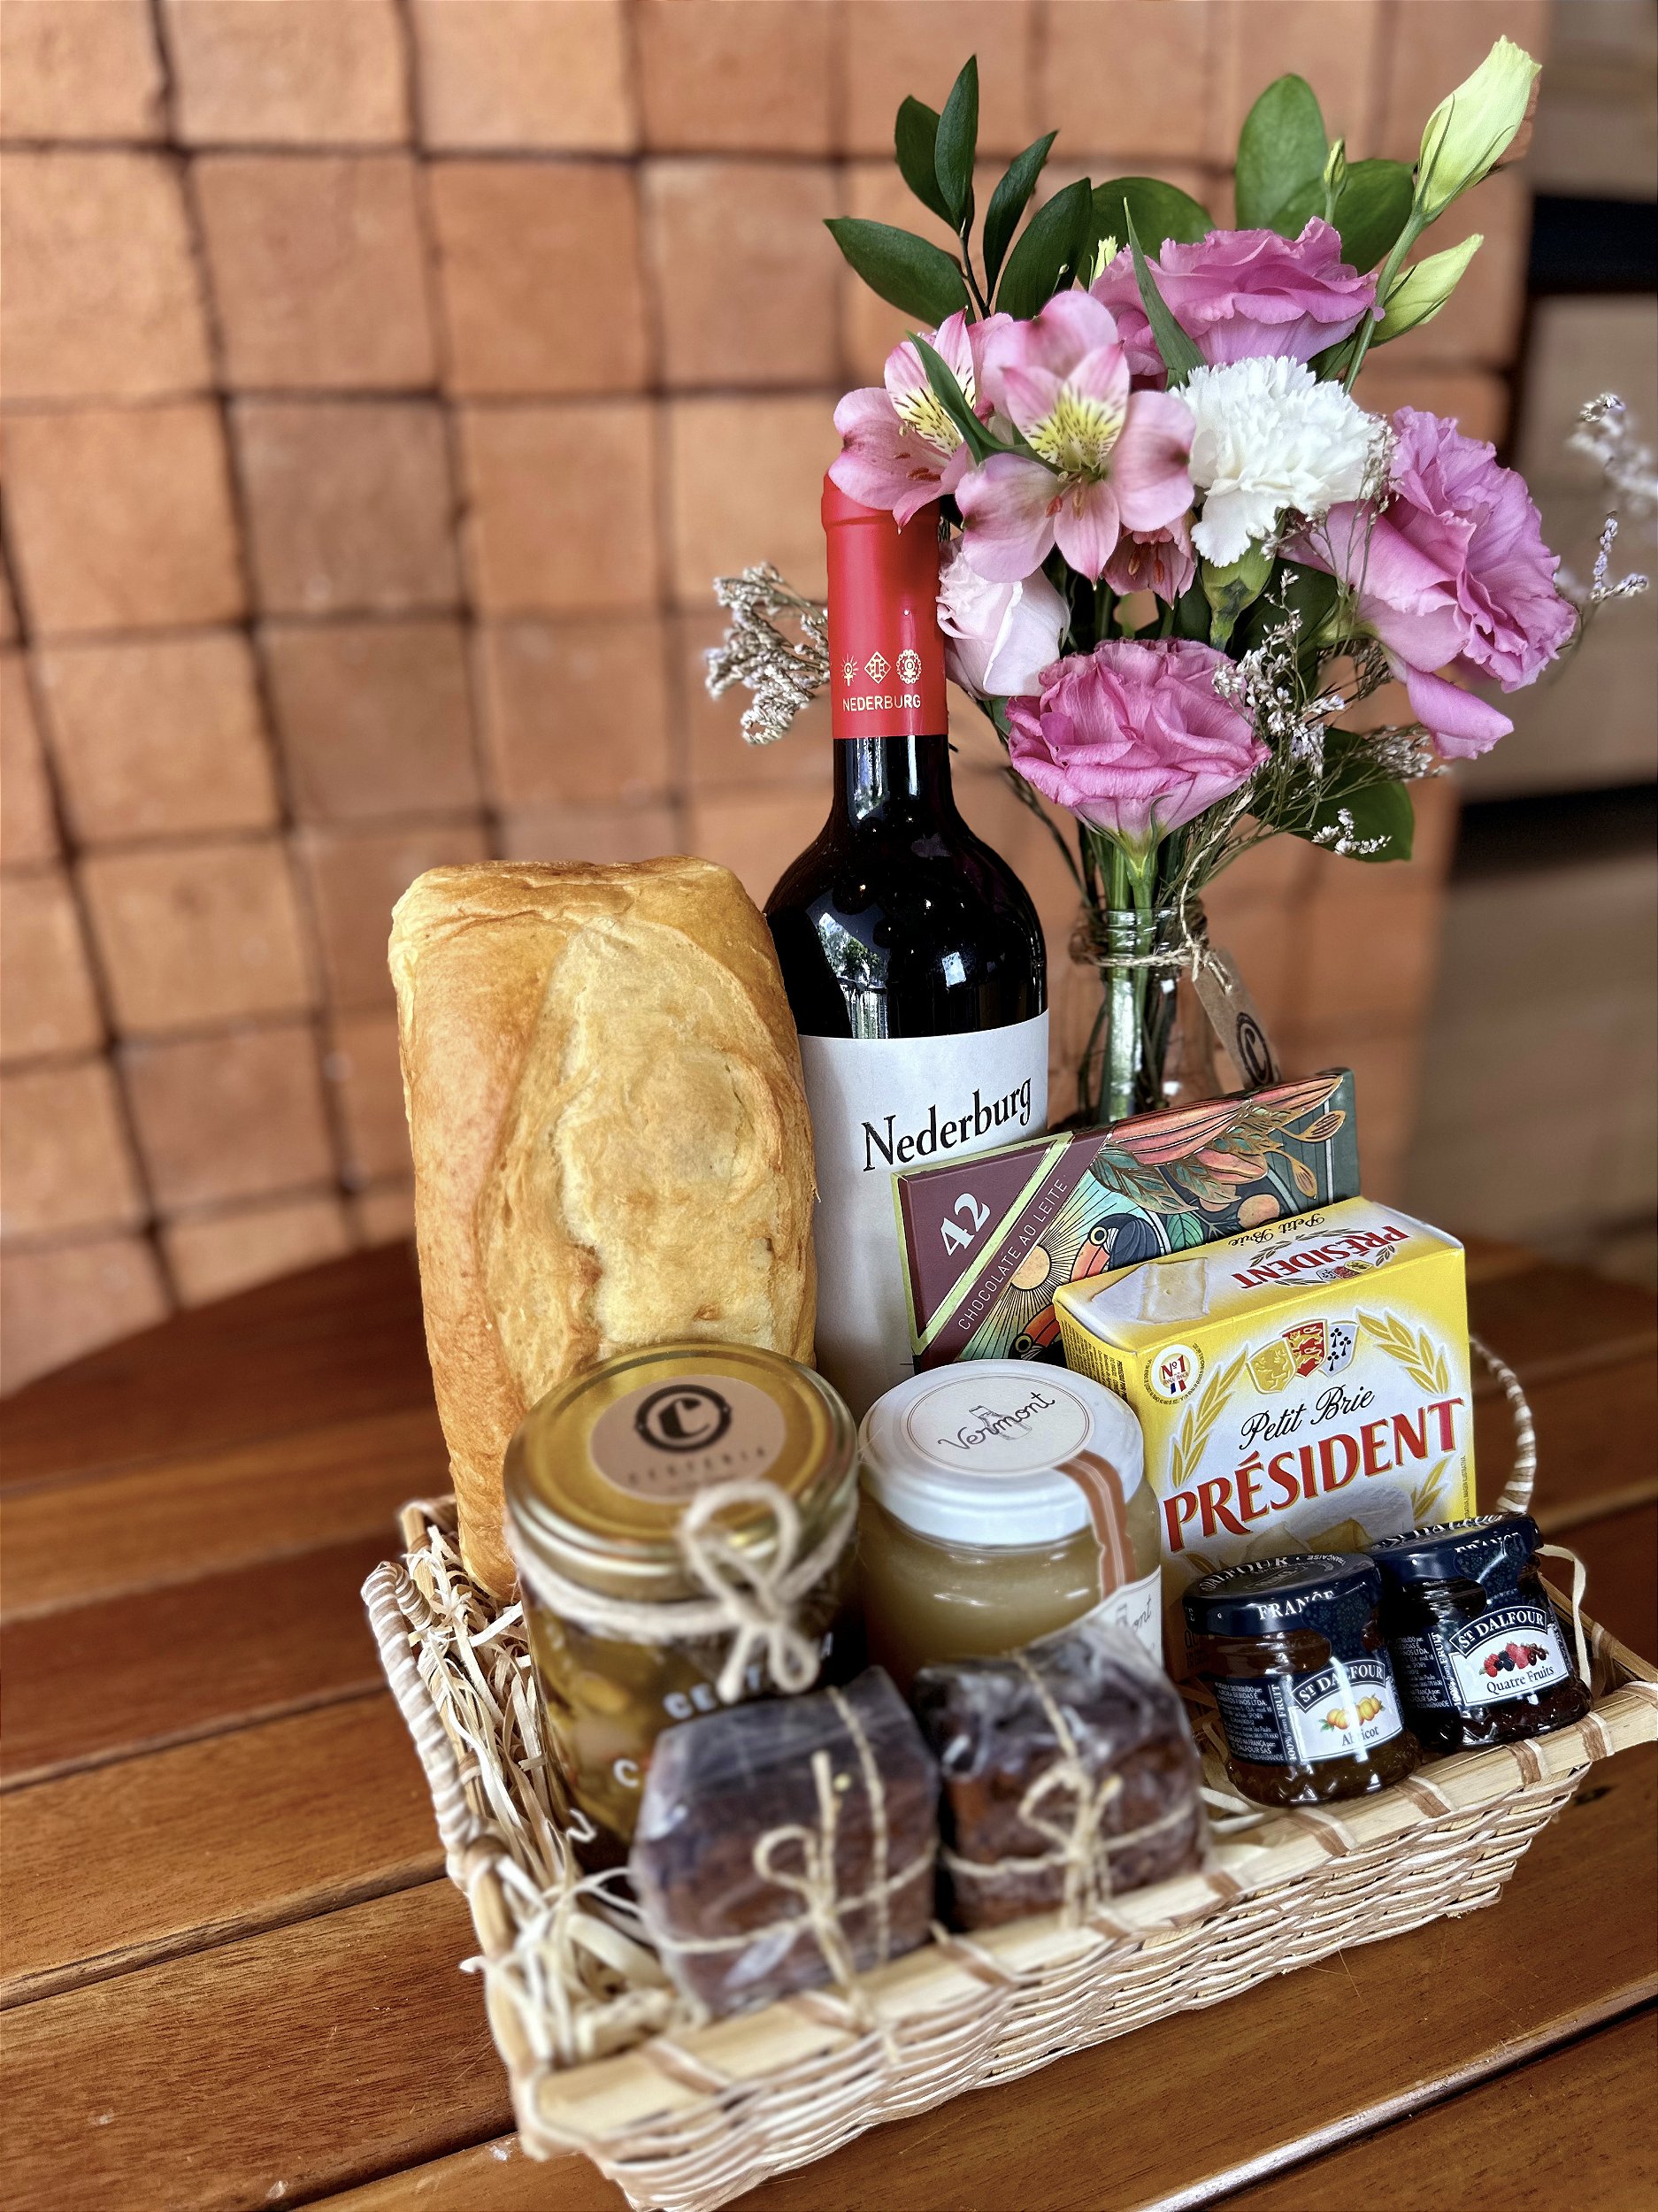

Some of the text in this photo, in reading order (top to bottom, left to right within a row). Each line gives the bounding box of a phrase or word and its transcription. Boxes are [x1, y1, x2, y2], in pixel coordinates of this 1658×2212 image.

[842, 694, 921, 712] NEDERBURG
[862, 1077, 1032, 1171] Nederburg
[940, 1193, 991, 1256] 42
[1227, 1214, 1325, 1247] Petit Brie
[958, 1179, 1068, 1330] CHOCOLATE AO LEITE
[1232, 1225, 1409, 1290] PRÉSIDENT
[937, 1392, 1055, 1449] Vermont
[1239, 1384, 1377, 1450] Petit Brie
[1163, 1398, 1465, 1553] PRÉSIDENT
[1474, 1610, 1545, 1637] DALFOUR
[1431, 1632, 1448, 1664] FRUIT
[1316, 1663, 1383, 1692] DAFOUR
[1486, 1665, 1554, 1695] Quatre Fruits
[1270, 1684, 1286, 1717] FRUIT
[1284, 1735, 1297, 1761] 100%
[1341, 1725, 1380, 1747] Aicot
